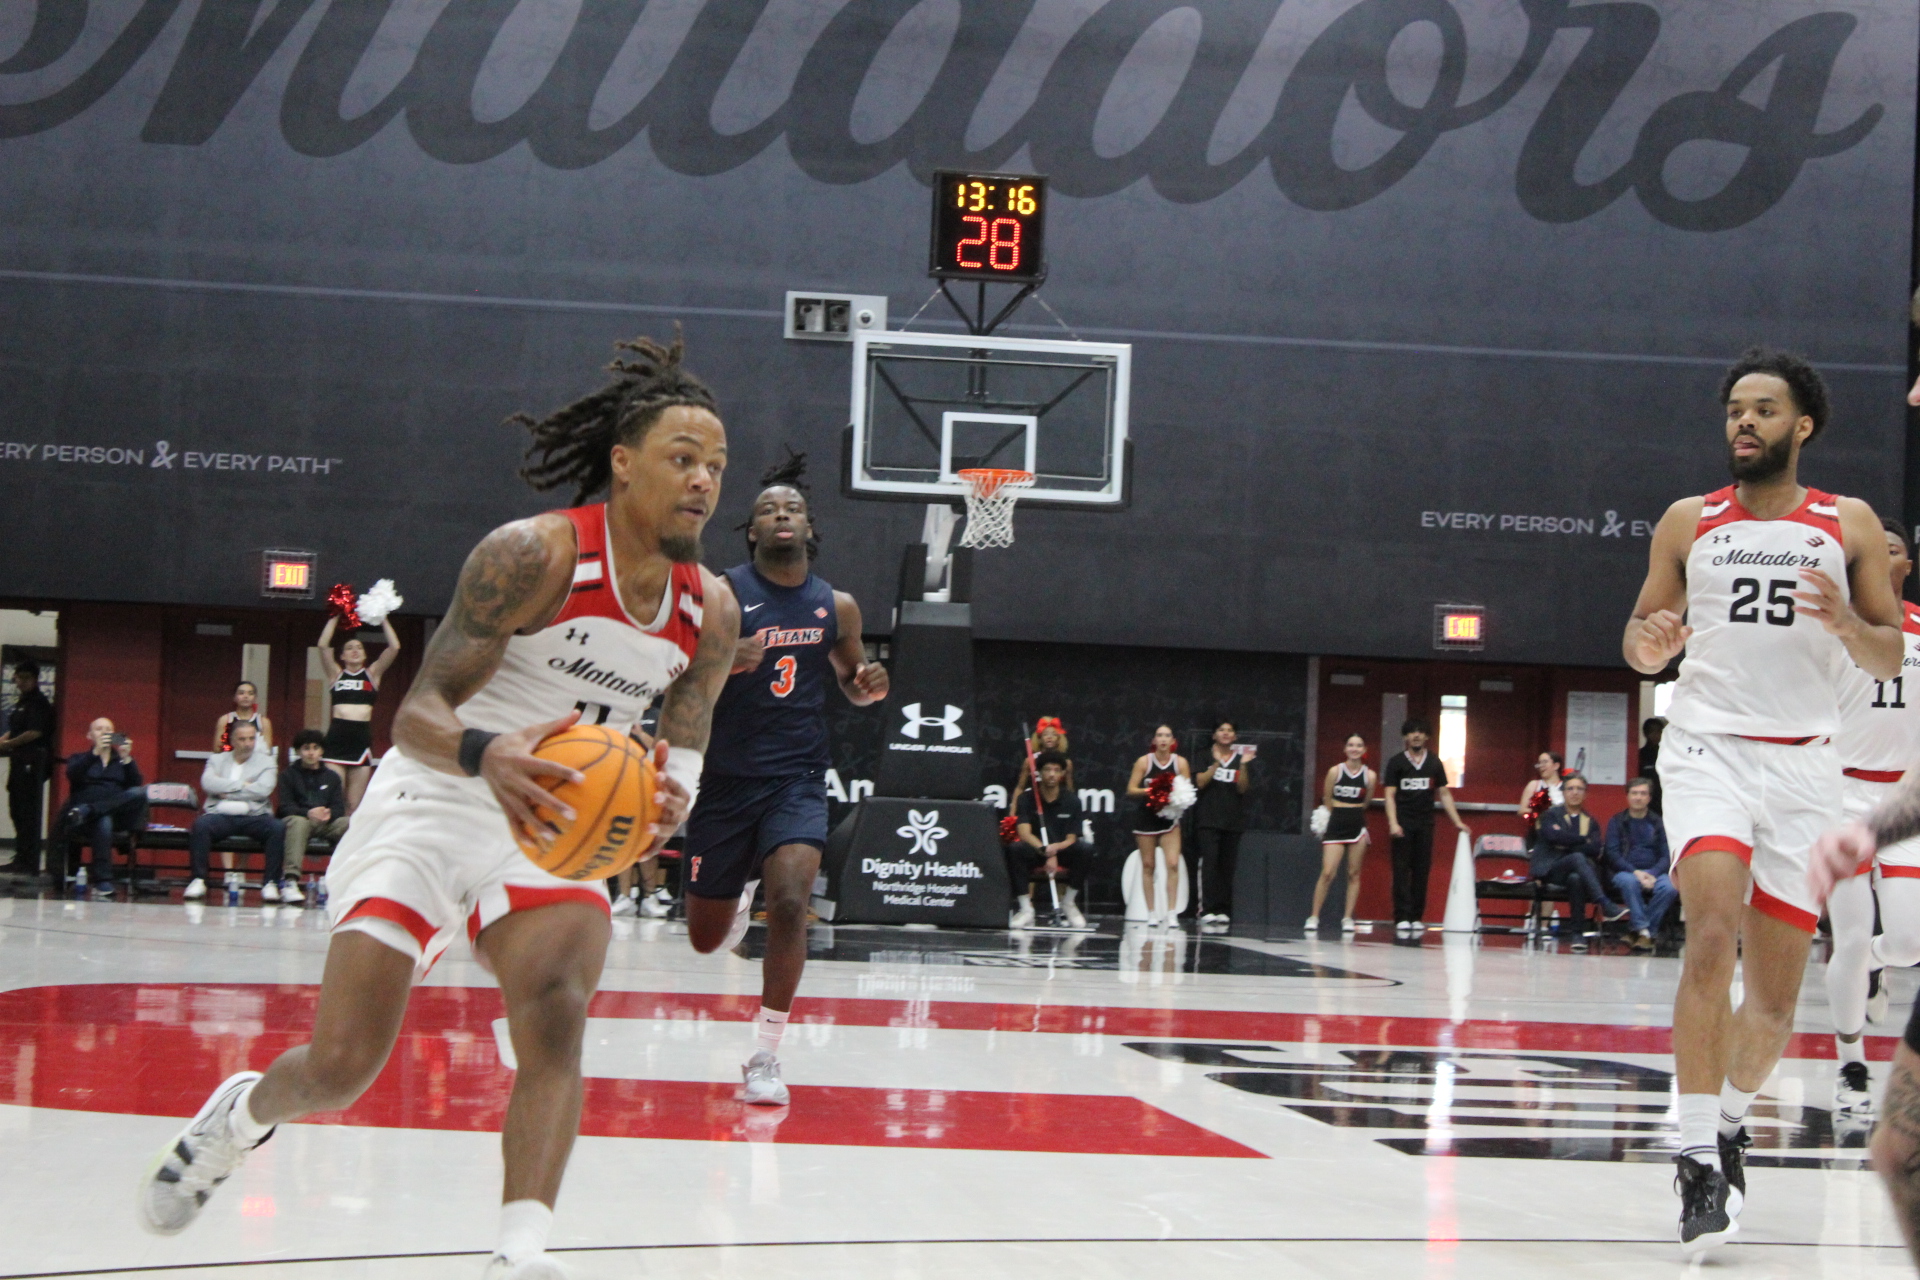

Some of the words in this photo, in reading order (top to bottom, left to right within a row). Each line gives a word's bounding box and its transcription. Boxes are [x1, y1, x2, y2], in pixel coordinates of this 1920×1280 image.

[958, 181, 1036, 215] 13:16
[956, 215, 1021, 270] 28
[41, 444, 144, 465] PERSON
[151, 440, 178, 469] &
[184, 451, 261, 472] EVERY
[1421, 511, 1495, 530] EVERY
[1500, 514, 1595, 534] PERSON
[1600, 509, 1625, 538] &
[1712, 549, 1821, 569] Matadors
[274, 563, 308, 586] EXIT
[1729, 577, 1797, 627] 25
[1448, 616, 1478, 638] EXIT
[547, 657, 664, 698] Matado
[770, 655, 798, 698] 3
[1871, 676, 1905, 709] 11
[889, 742, 926, 751] UNDER
[926, 744, 973, 754] ARMOUR
[861, 858, 923, 880] Dignity
[872, 881, 927, 895] Northridge
[927, 883, 968, 896] Hospital
[883, 894, 921, 906] Medical
[922, 896, 956, 907] Center
